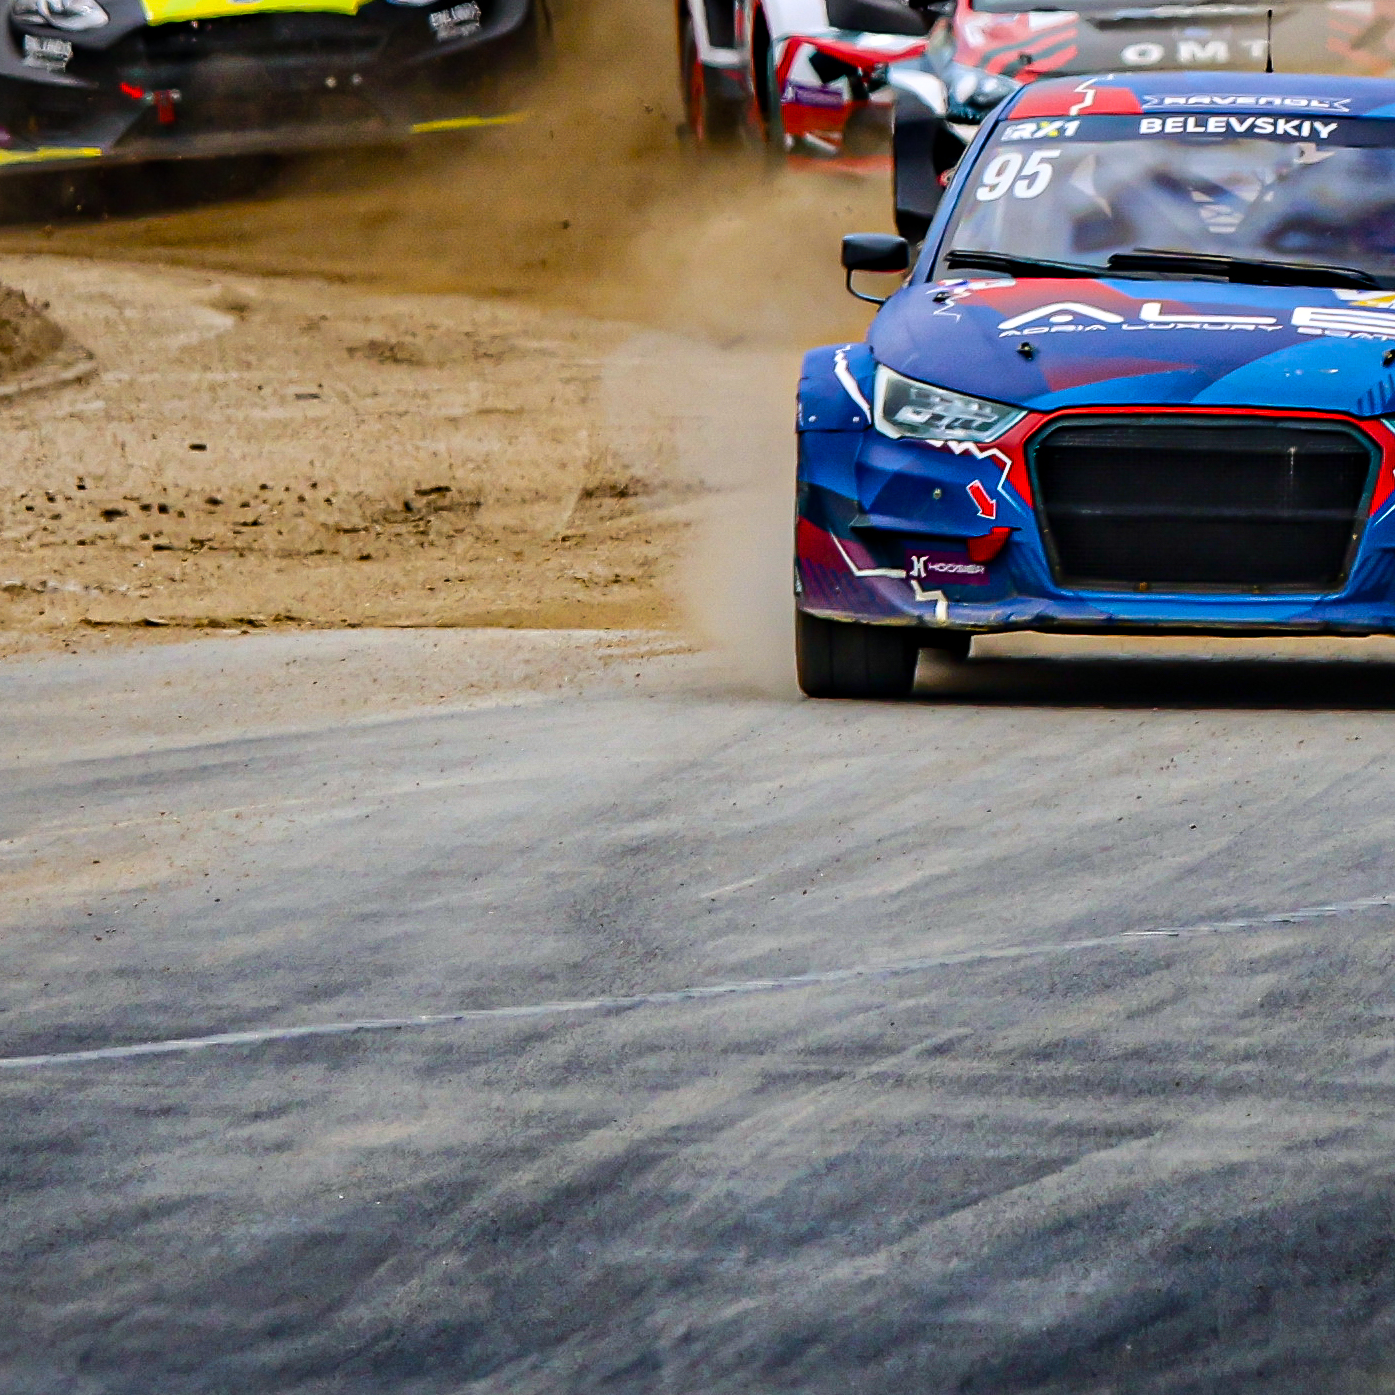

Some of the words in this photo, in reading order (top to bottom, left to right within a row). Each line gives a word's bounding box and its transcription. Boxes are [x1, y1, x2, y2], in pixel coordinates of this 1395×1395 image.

[1163, 96, 1331, 108] RAVENOL
[1008, 119, 1082, 140] RX1
[1138, 116, 1339, 139] BELEVSKIY
[975, 149, 1062, 202] 95
[998, 324, 1107, 338] ADRIA
[1121, 323, 1284, 333] LUXURY
[927, 562, 985, 575] HOOSIER
